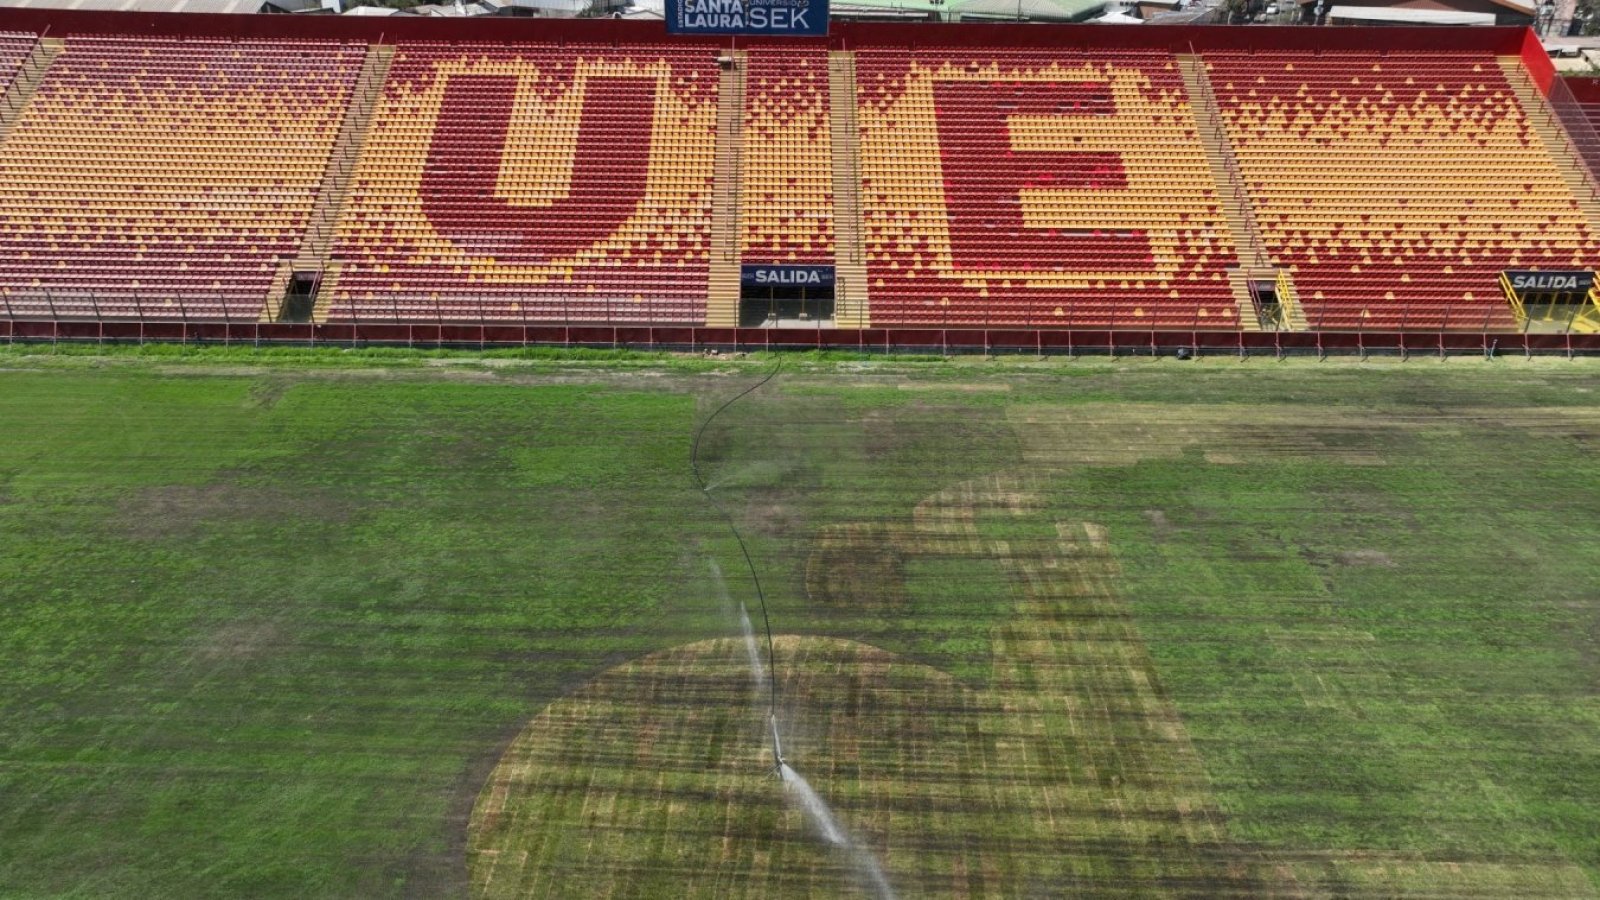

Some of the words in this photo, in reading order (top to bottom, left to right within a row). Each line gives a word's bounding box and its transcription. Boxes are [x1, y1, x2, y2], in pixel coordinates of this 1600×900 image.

[685, 0, 744, 13] SANTA
[685, 13, 744, 28] LAURA
[749, 7, 810, 28] SEK
[755, 269, 821, 283] SALIDA
[1512, 275, 1577, 288] SALIDA
